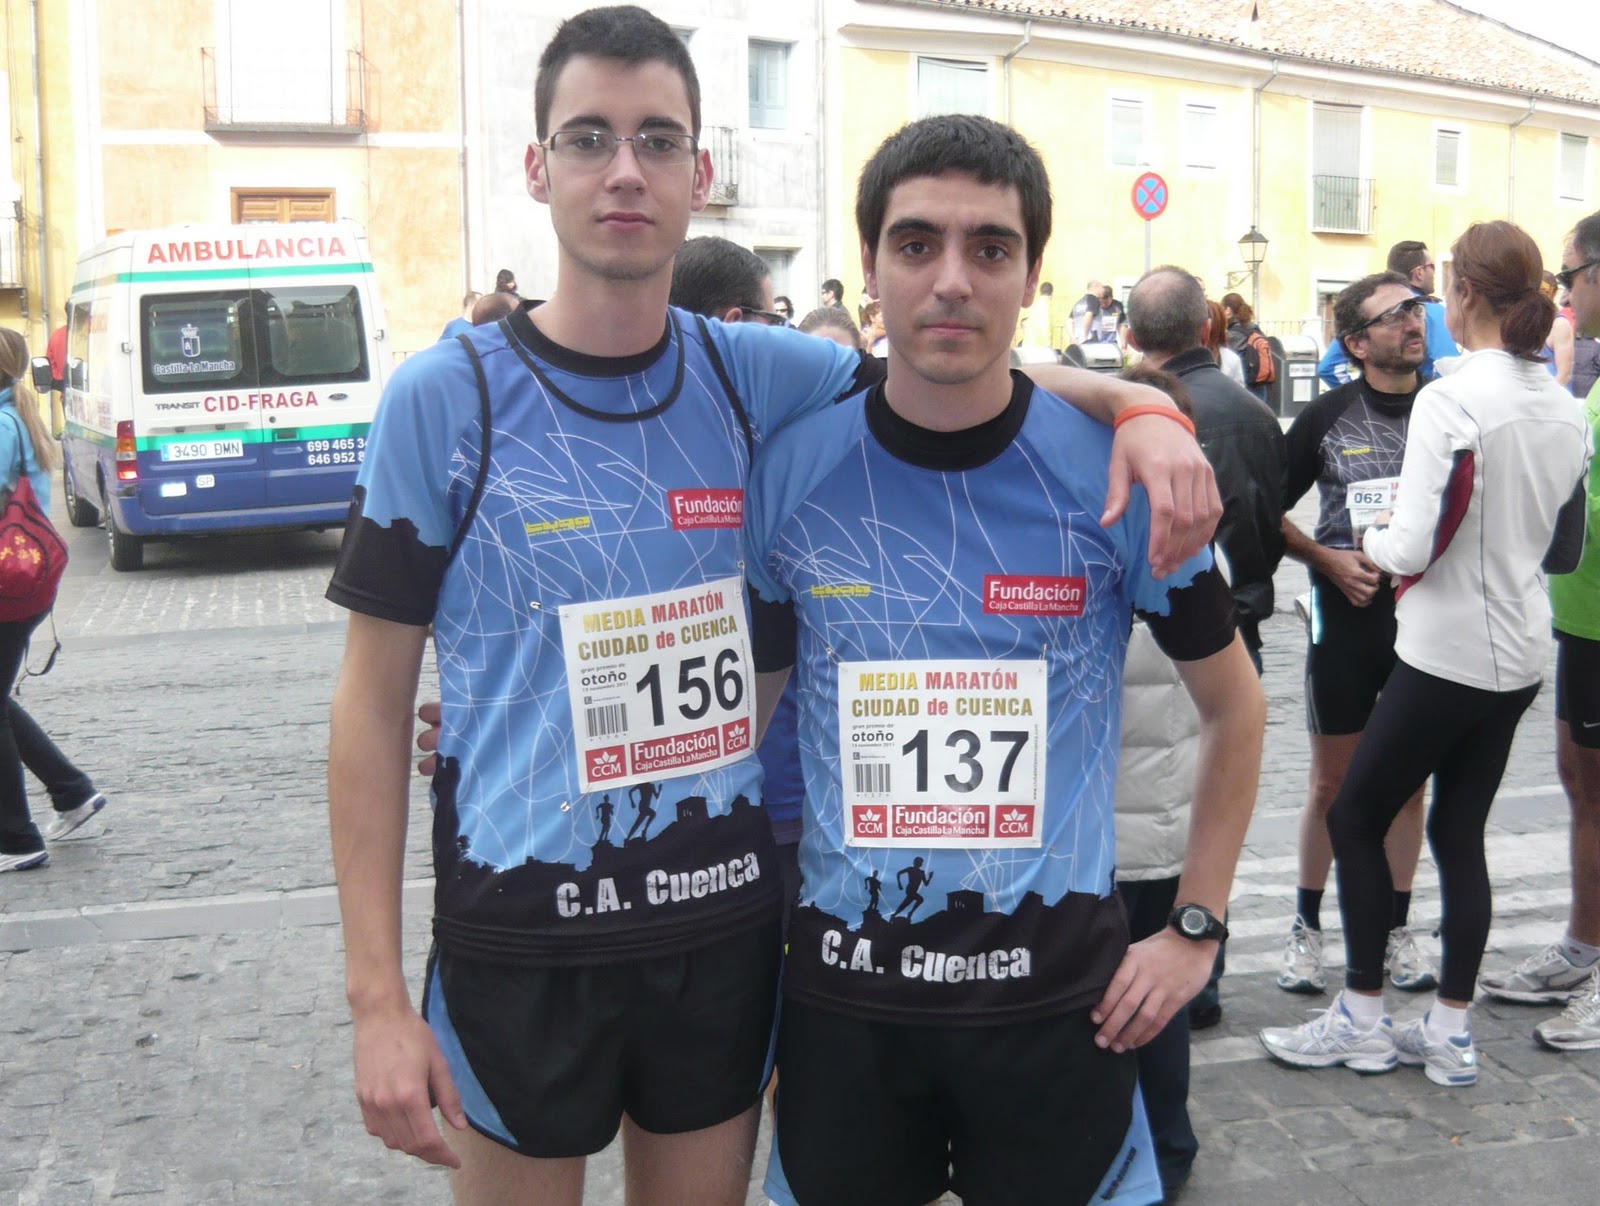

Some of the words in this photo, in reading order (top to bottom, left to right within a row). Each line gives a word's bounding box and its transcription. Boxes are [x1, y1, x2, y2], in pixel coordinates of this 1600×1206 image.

[147, 237, 347, 264] AMBULANCIA
[200, 360, 235, 371] Mancha
[155, 402, 200, 410] TRANSIT
[204, 391, 318, 412] CID-FRAGA
[174, 445, 207, 457] 3490
[214, 442, 240, 455] DMN
[307, 441, 330, 452] 699
[332, 439, 355, 450] 465
[308, 455, 331, 465] 646
[333, 453, 355, 463] 952
[199, 477, 212, 486] SP
[674, 494, 742, 515] Fundación
[1354, 492, 1382, 504] 062
[989, 580, 1080, 602] Fundación
[583, 608, 645, 633] MEDIA
[651, 590, 724, 624] MARATÓN
[989, 600, 1007, 611] Caja
[1008, 601, 1038, 611] Castilla
[1039, 602, 1048, 611] La
[1049, 603, 1079, 612] Mancha
[578, 634, 649, 661] CIUDAD
[655, 631, 675, 650] de
[681, 615, 738, 645] CUENCA
[581, 670, 627, 686] otoño
[859, 672, 918, 691] MEDIA
[925, 668, 1018, 690] MARATÓN
[636, 648, 744, 727] 156
[852, 698, 920, 717] CIUDAD
[927, 698, 948, 715] de
[955, 697, 1033, 716] CUENCA
[726, 735, 747, 750] CCM
[852, 730, 894, 742] otoño
[634, 732, 717, 761] Fundación
[635, 763, 653, 772] Caja
[653, 757, 682, 768] Castilla
[682, 755, 691, 763] La
[691, 749, 718, 762] Mancha
[902, 729, 1029, 793] 137
[591, 763, 622, 778] CCM
[895, 806, 985, 824] Fundación
[857, 822, 883, 834] CCM
[895, 825, 912, 836] Caja
[913, 825, 942, 835] Castilla
[943, 826, 953, 834] La
[953, 825, 985, 834] Mancha
[999, 822, 1028, 834] CCM
[556, 877, 631, 918] C.A.
[646, 852, 760, 905] Cuenca
[821, 929, 884, 974] C.A.
[901, 944, 1031, 984] Cuenca
